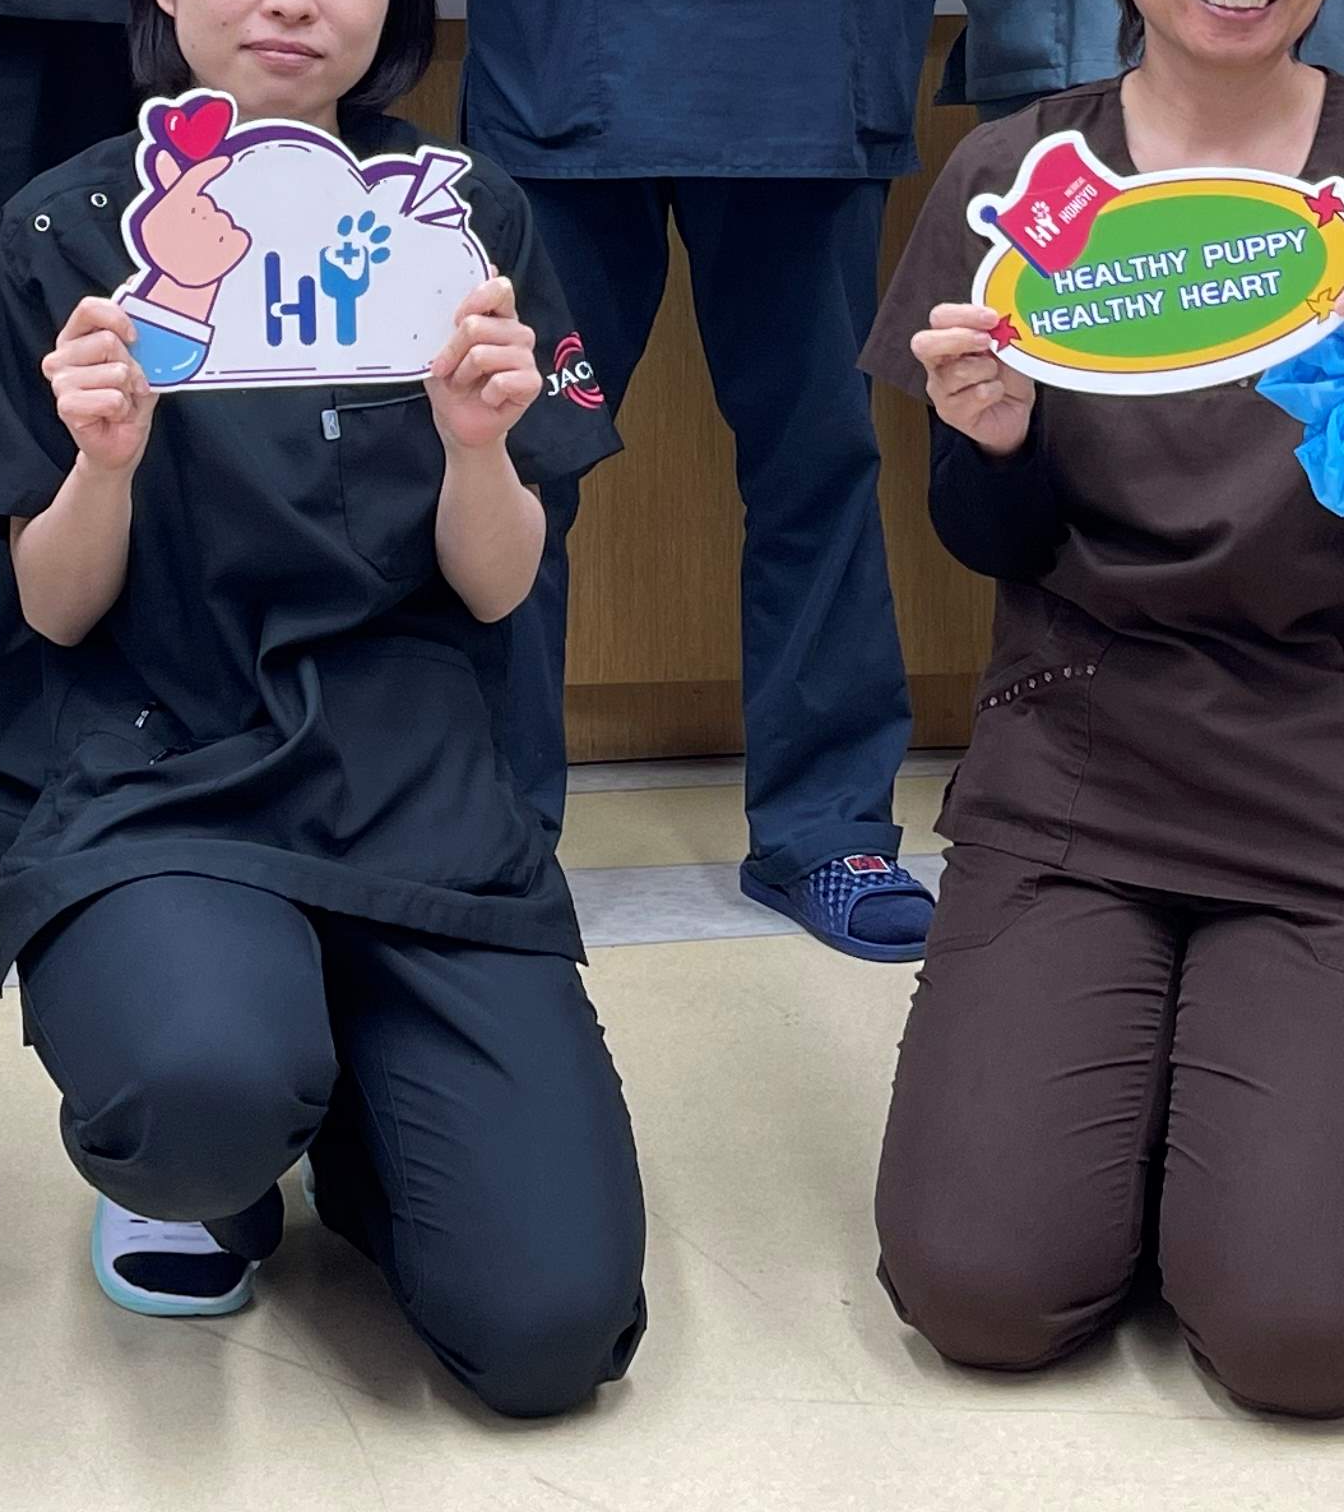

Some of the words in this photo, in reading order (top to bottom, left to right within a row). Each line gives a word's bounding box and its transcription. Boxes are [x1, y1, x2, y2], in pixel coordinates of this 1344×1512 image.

[1054, 248, 1189, 296] HEALTHY
[1201, 227, 1309, 268] PUPPY
[1029, 289, 1164, 338] HEALTHY
[1179, 268, 1283, 311] HEART
